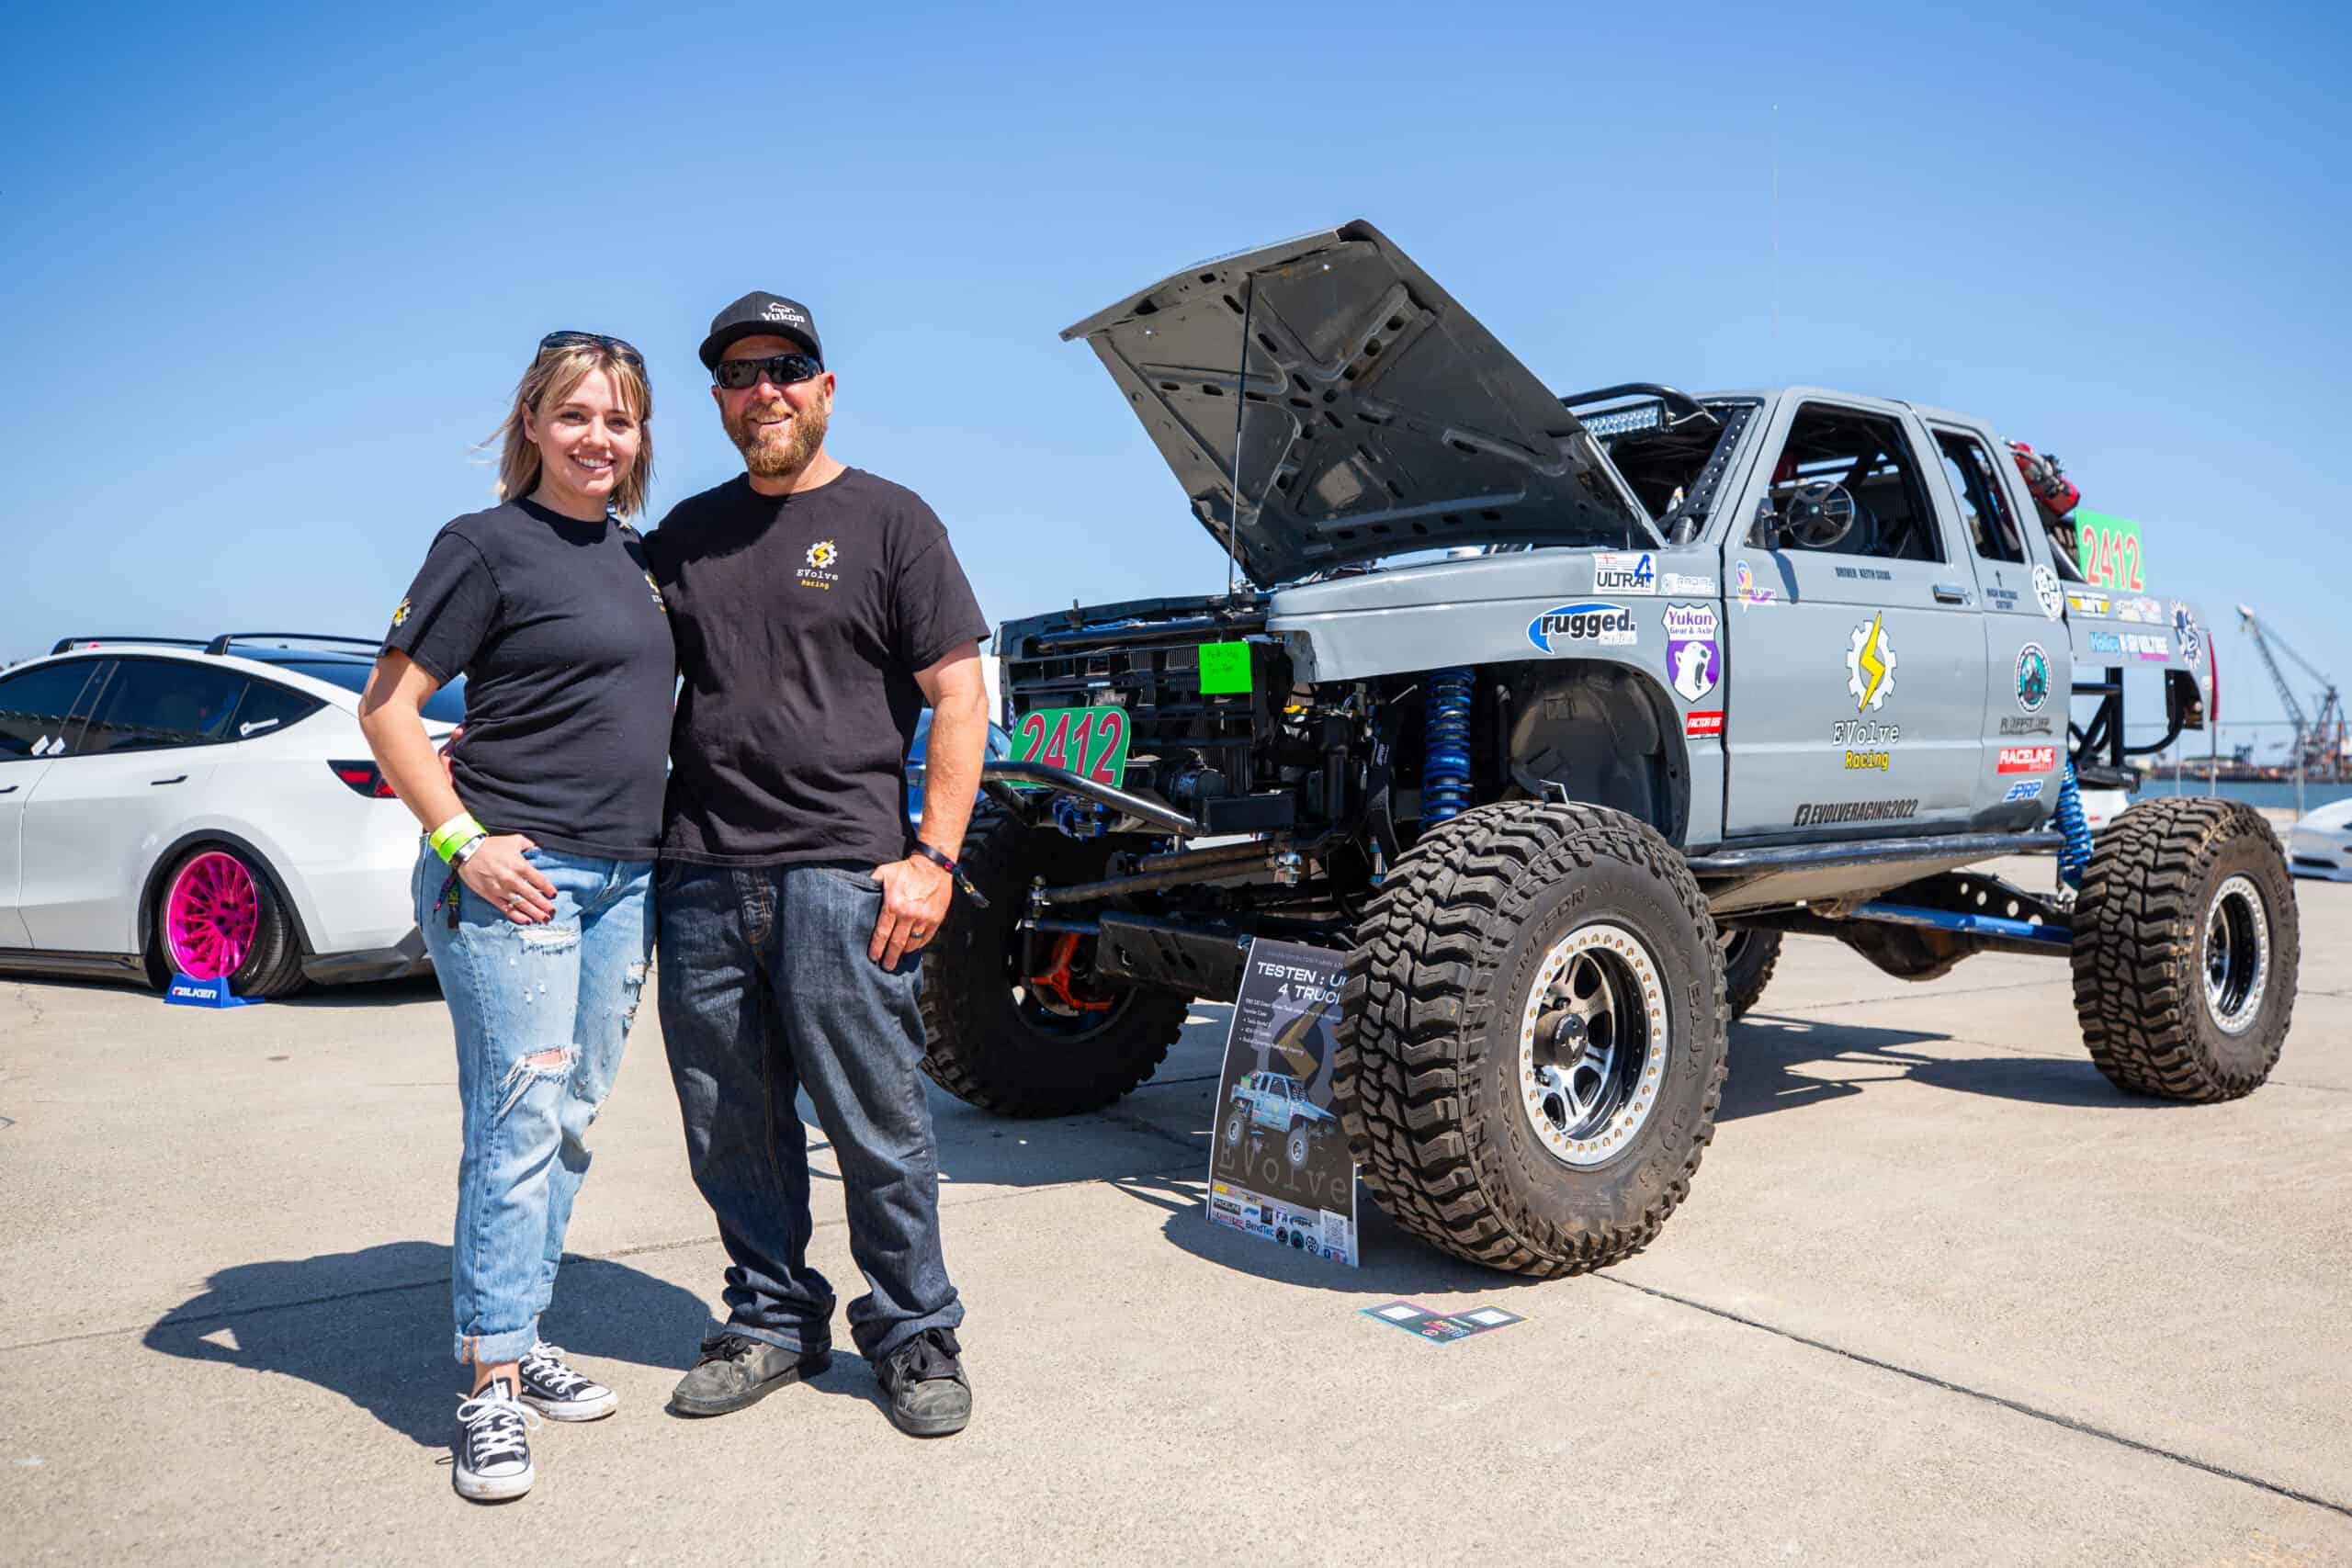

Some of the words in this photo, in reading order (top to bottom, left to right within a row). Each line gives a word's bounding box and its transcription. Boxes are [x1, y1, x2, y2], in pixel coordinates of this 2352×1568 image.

[762, 312, 805, 322] Yukon
[2082, 525, 2143, 591] 2412
[797, 569, 839, 581] EVolve
[1597, 571, 1645, 587] ULTRA
[801, 580, 830, 591] Racing
[1668, 611, 1712, 626] Yukon
[1832, 720, 1901, 746] EVolve
[1023, 712, 1123, 784] 2412
[1845, 750, 1889, 772] Racing
[2000, 749, 2053, 765] RACELINE
[1809, 799, 1918, 824] EVOLVERACING2022
[1257, 962, 1317, 984] TESTEN
[1278, 983, 1288, 997] 4
